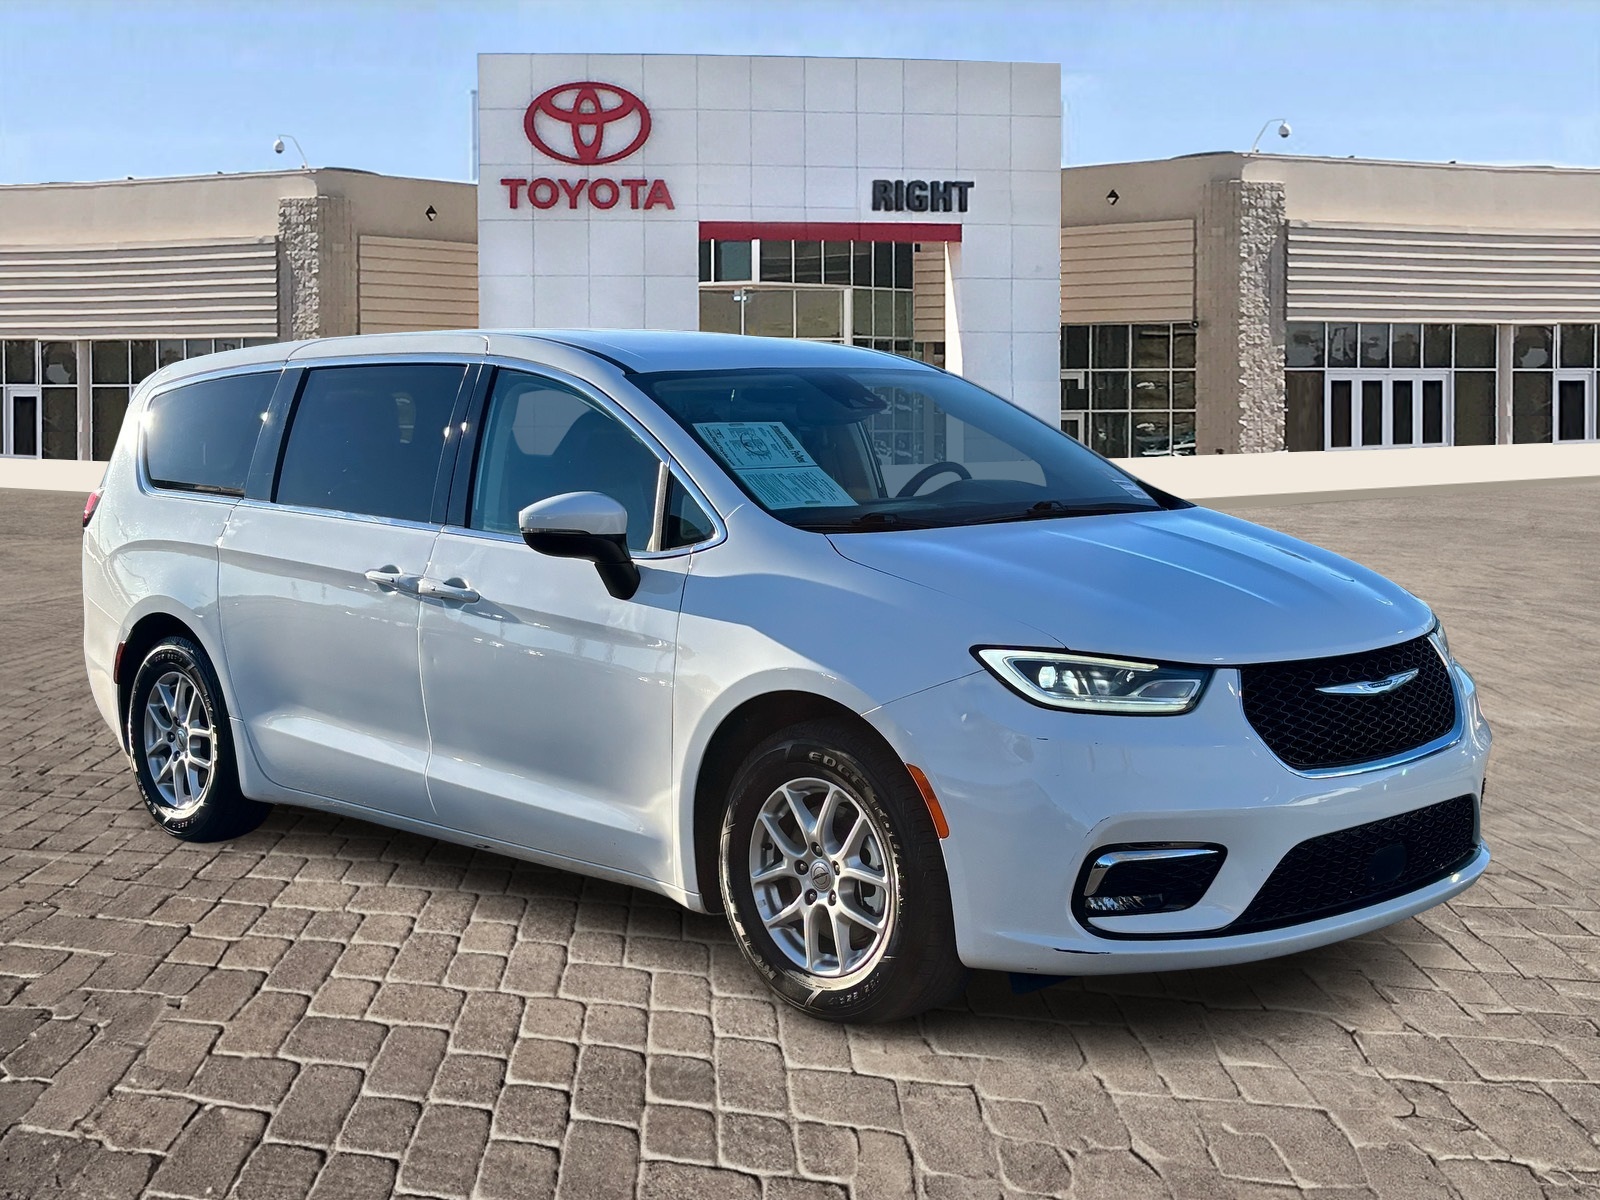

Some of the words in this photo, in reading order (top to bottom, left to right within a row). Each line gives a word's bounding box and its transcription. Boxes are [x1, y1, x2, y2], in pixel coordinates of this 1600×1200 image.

[500, 177, 675, 210] TOYOTA
[872, 179, 975, 212] RIGHT
[808, 751, 870, 789] EDGE
